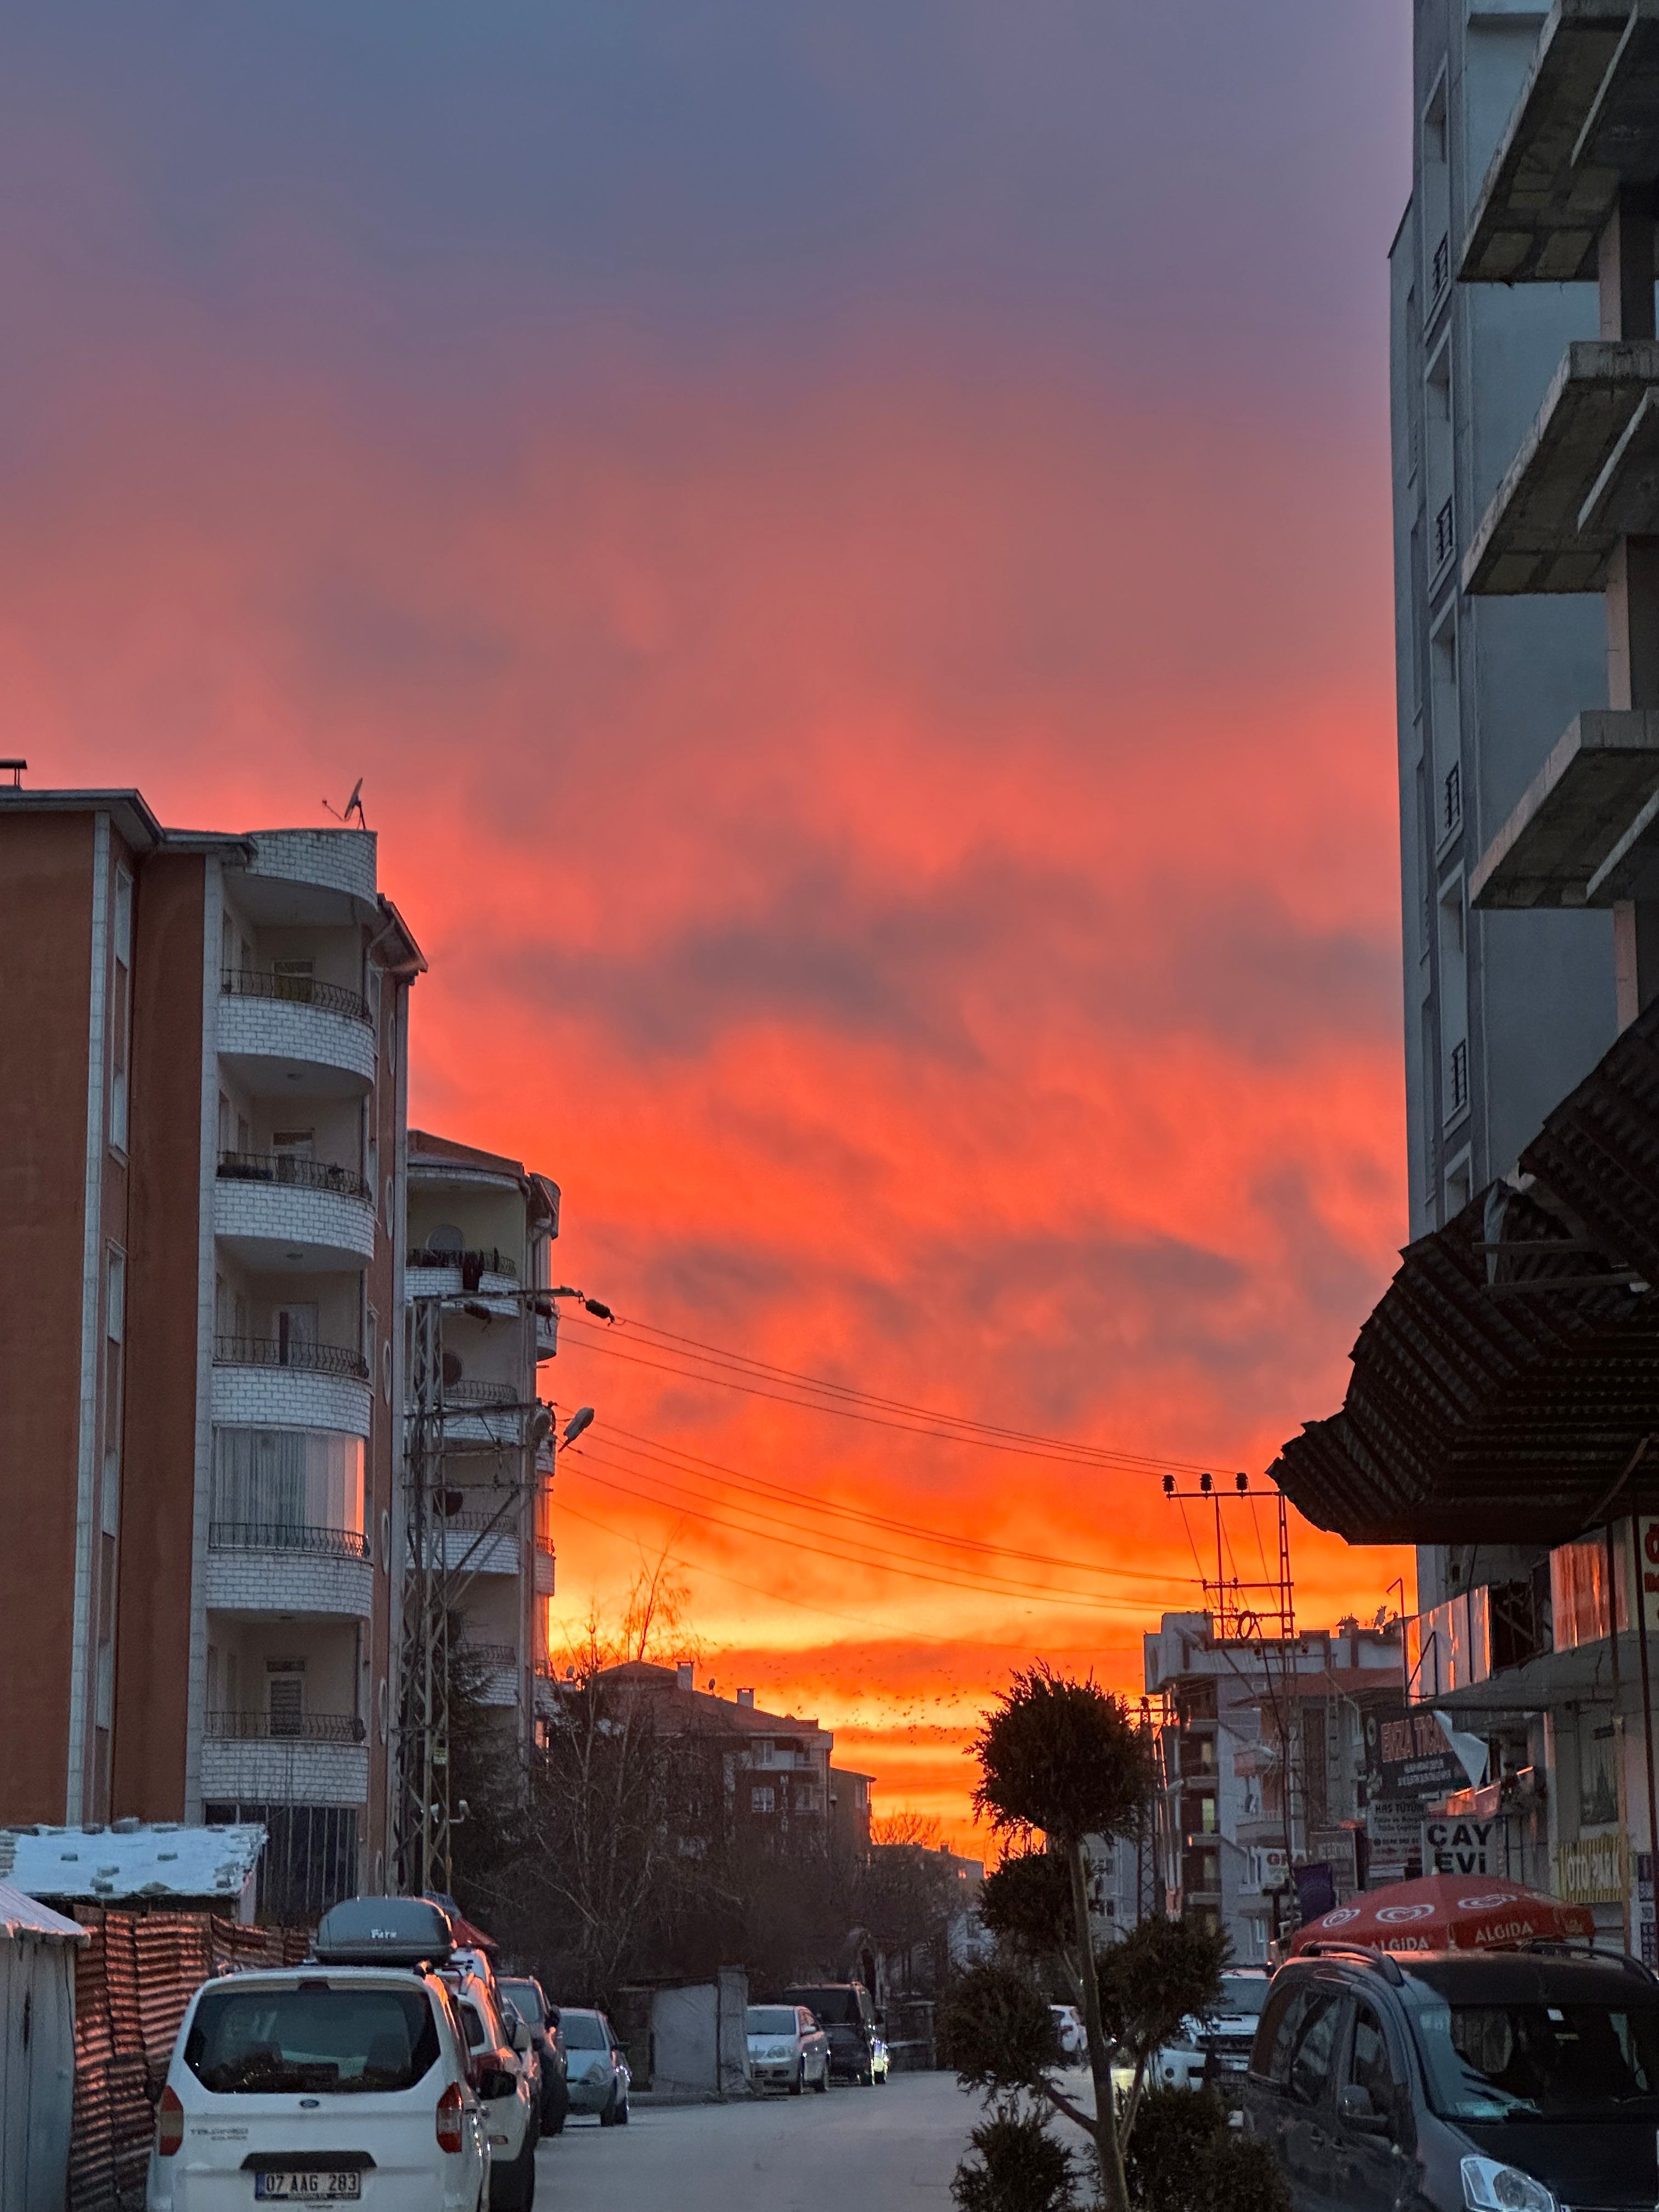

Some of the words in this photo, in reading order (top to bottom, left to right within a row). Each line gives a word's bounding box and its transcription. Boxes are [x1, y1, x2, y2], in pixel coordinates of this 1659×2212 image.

[1427, 1824, 1493, 1852] ÇAY
[267, 2175, 284, 2192] 07
[290, 2175, 318, 2192] AAG
[329, 2174, 357, 2191] 283
